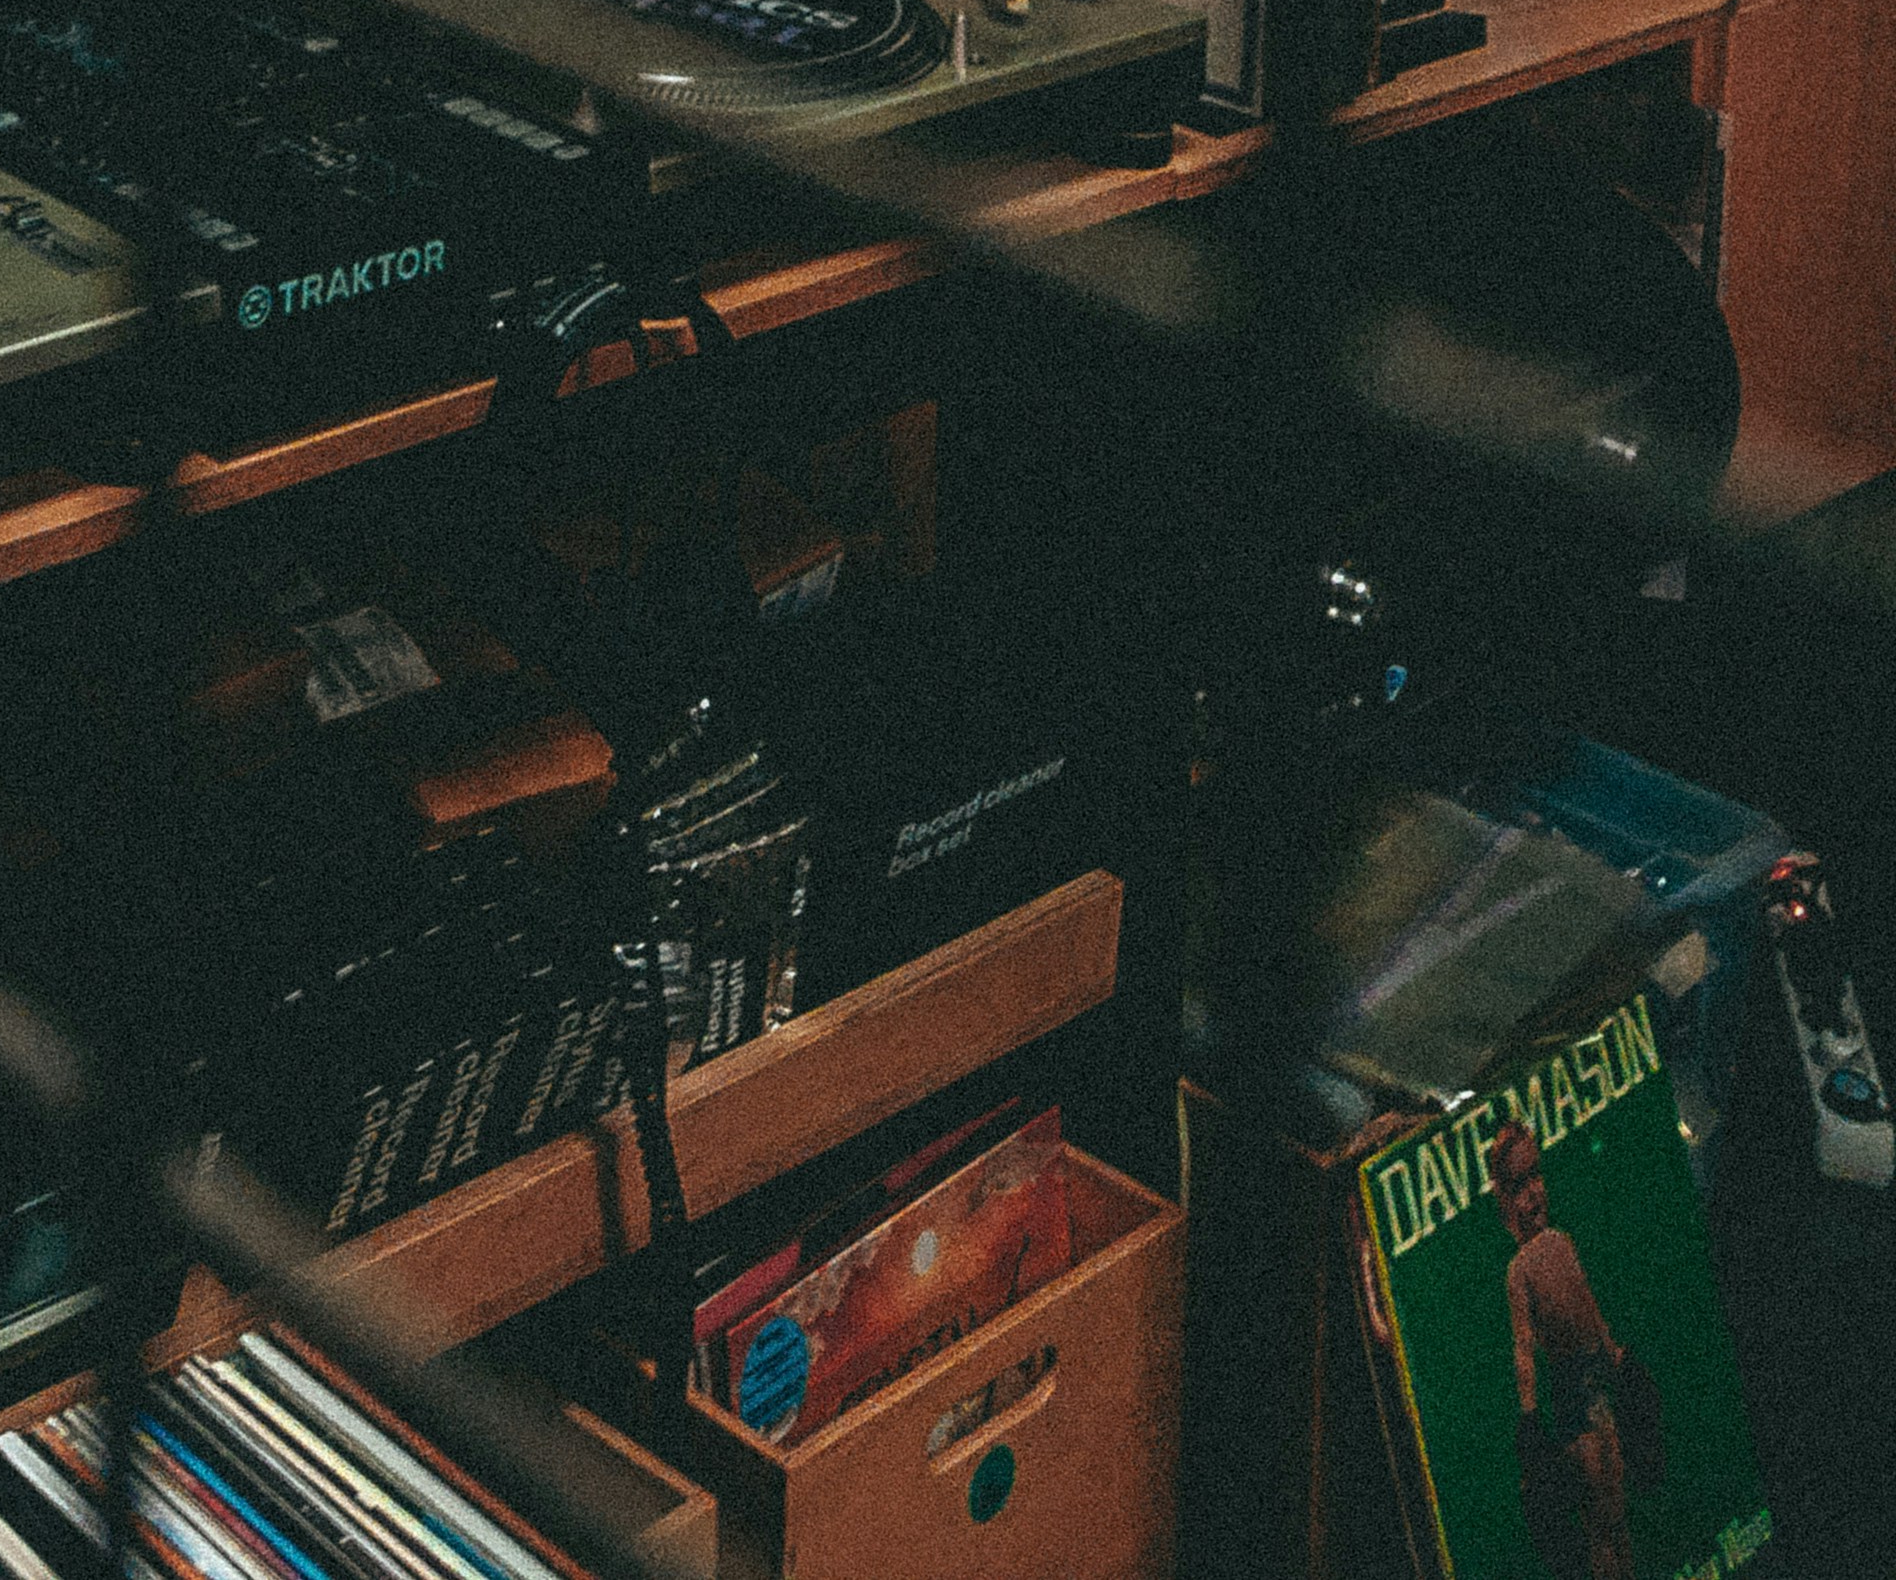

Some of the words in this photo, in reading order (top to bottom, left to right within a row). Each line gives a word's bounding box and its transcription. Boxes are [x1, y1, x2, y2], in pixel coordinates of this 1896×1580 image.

[278, 239, 447, 315] TRAKTOR
[699, 957, 728, 1054] Record
[1377, 1100, 1500, 1258] DAVE
[1502, 993, 1664, 1152] MASON
